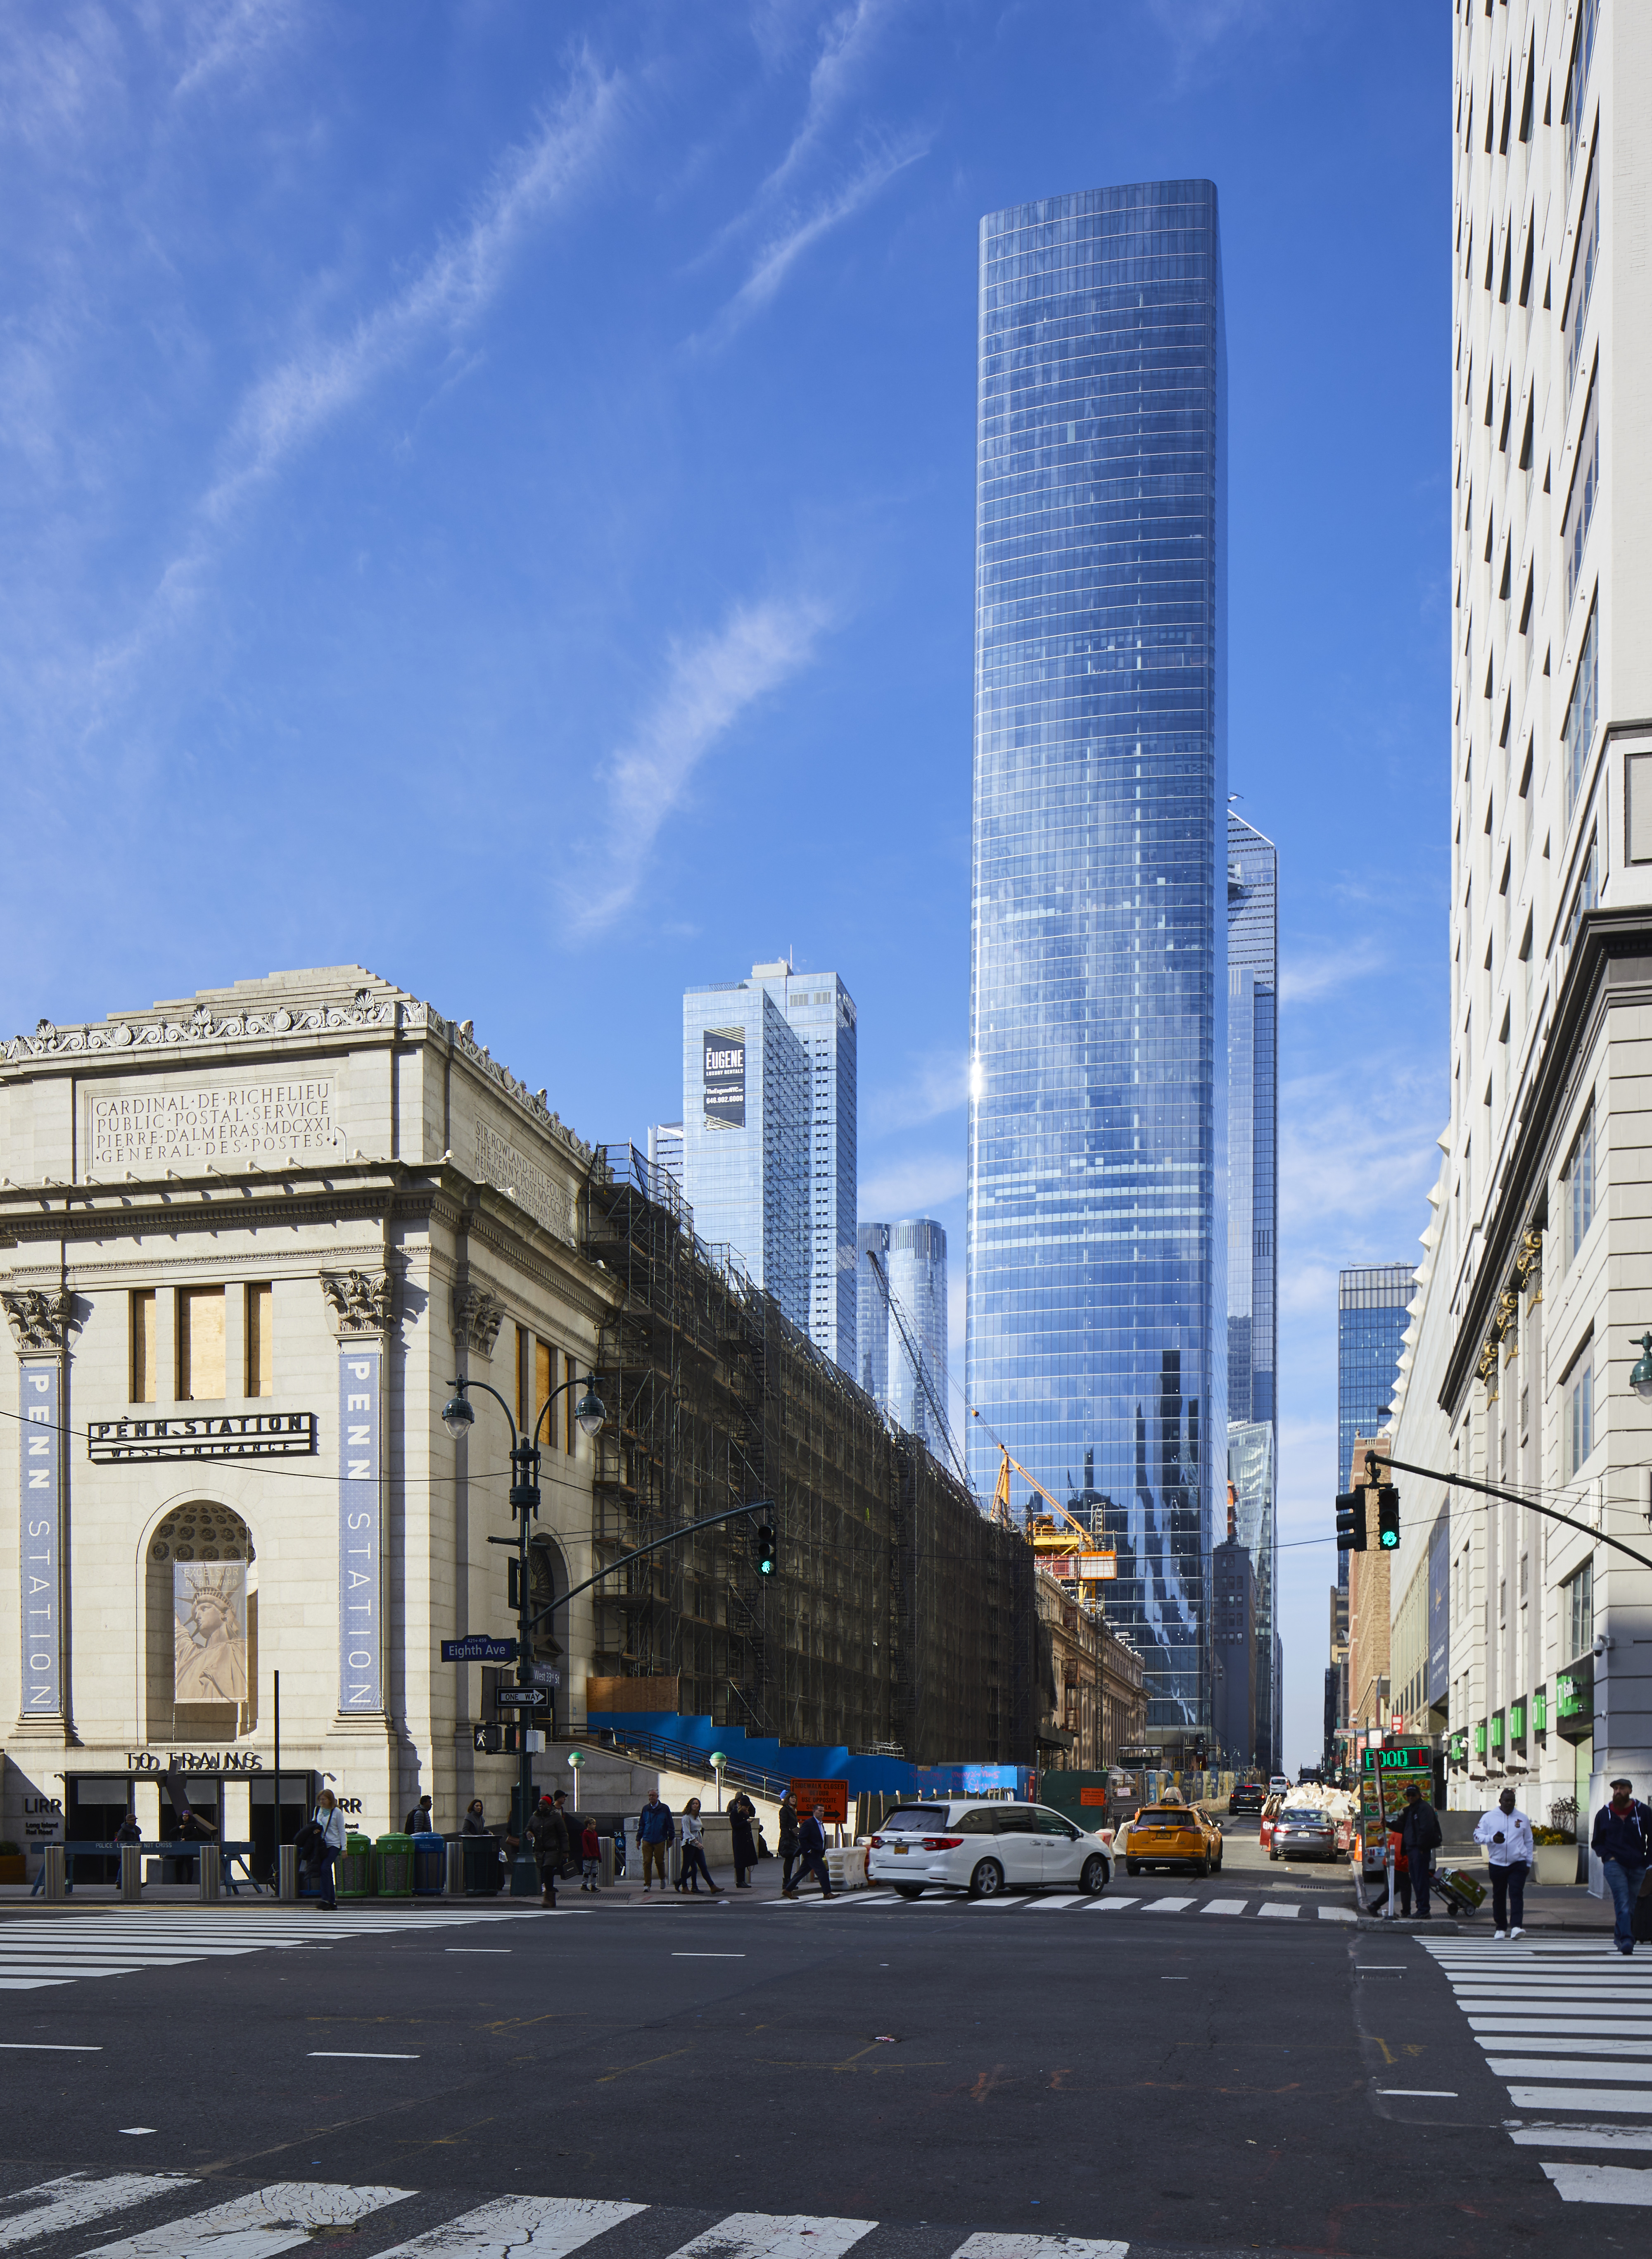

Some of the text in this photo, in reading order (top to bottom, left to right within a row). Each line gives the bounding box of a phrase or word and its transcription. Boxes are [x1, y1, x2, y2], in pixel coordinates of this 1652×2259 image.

[706, 1049, 743, 1069] EUGENE
[96, 1083, 328, 1116] CARDINAL DE RICHELIEU
[706, 1095, 743, 1104] 646.902.6000
[97, 1100, 328, 1133] PUBLIC POSTAL SERVICE
[97, 1131, 157, 1148] PIERRE
[265, 1117, 330, 1135] MDCXXI
[102, 1133, 323, 1163] GÉNÉRAL DES POSTES
[476, 1121, 490, 1144] SIR
[491, 1133, 528, 1173] ROWLAND
[529, 1164, 545, 1190] HILL
[476, 1136, 491, 1160] THE
[494, 1151, 520, 1181] PENNY
[520, 1173, 537, 1197] POST
[475, 1152, 506, 1186] HEINRICH
[521, 1189, 548, 1217] STEPHAN
[98, 1415, 301, 1438] PENN STATION
[28, 1374, 51, 1704] PENN STATION
[348, 1361, 371, 1703] PENN STATION
[184, 1567, 238, 1577] EXCELSIOR
[449, 1644, 506, 1658] Eighth Ave
[534, 1670, 560, 1684] West 33rd St
[124, 1752, 255, 1769] TO TRAINS
[1366, 1751, 1409, 1768] FOOD
[25, 1798, 62, 1813] LIRR
